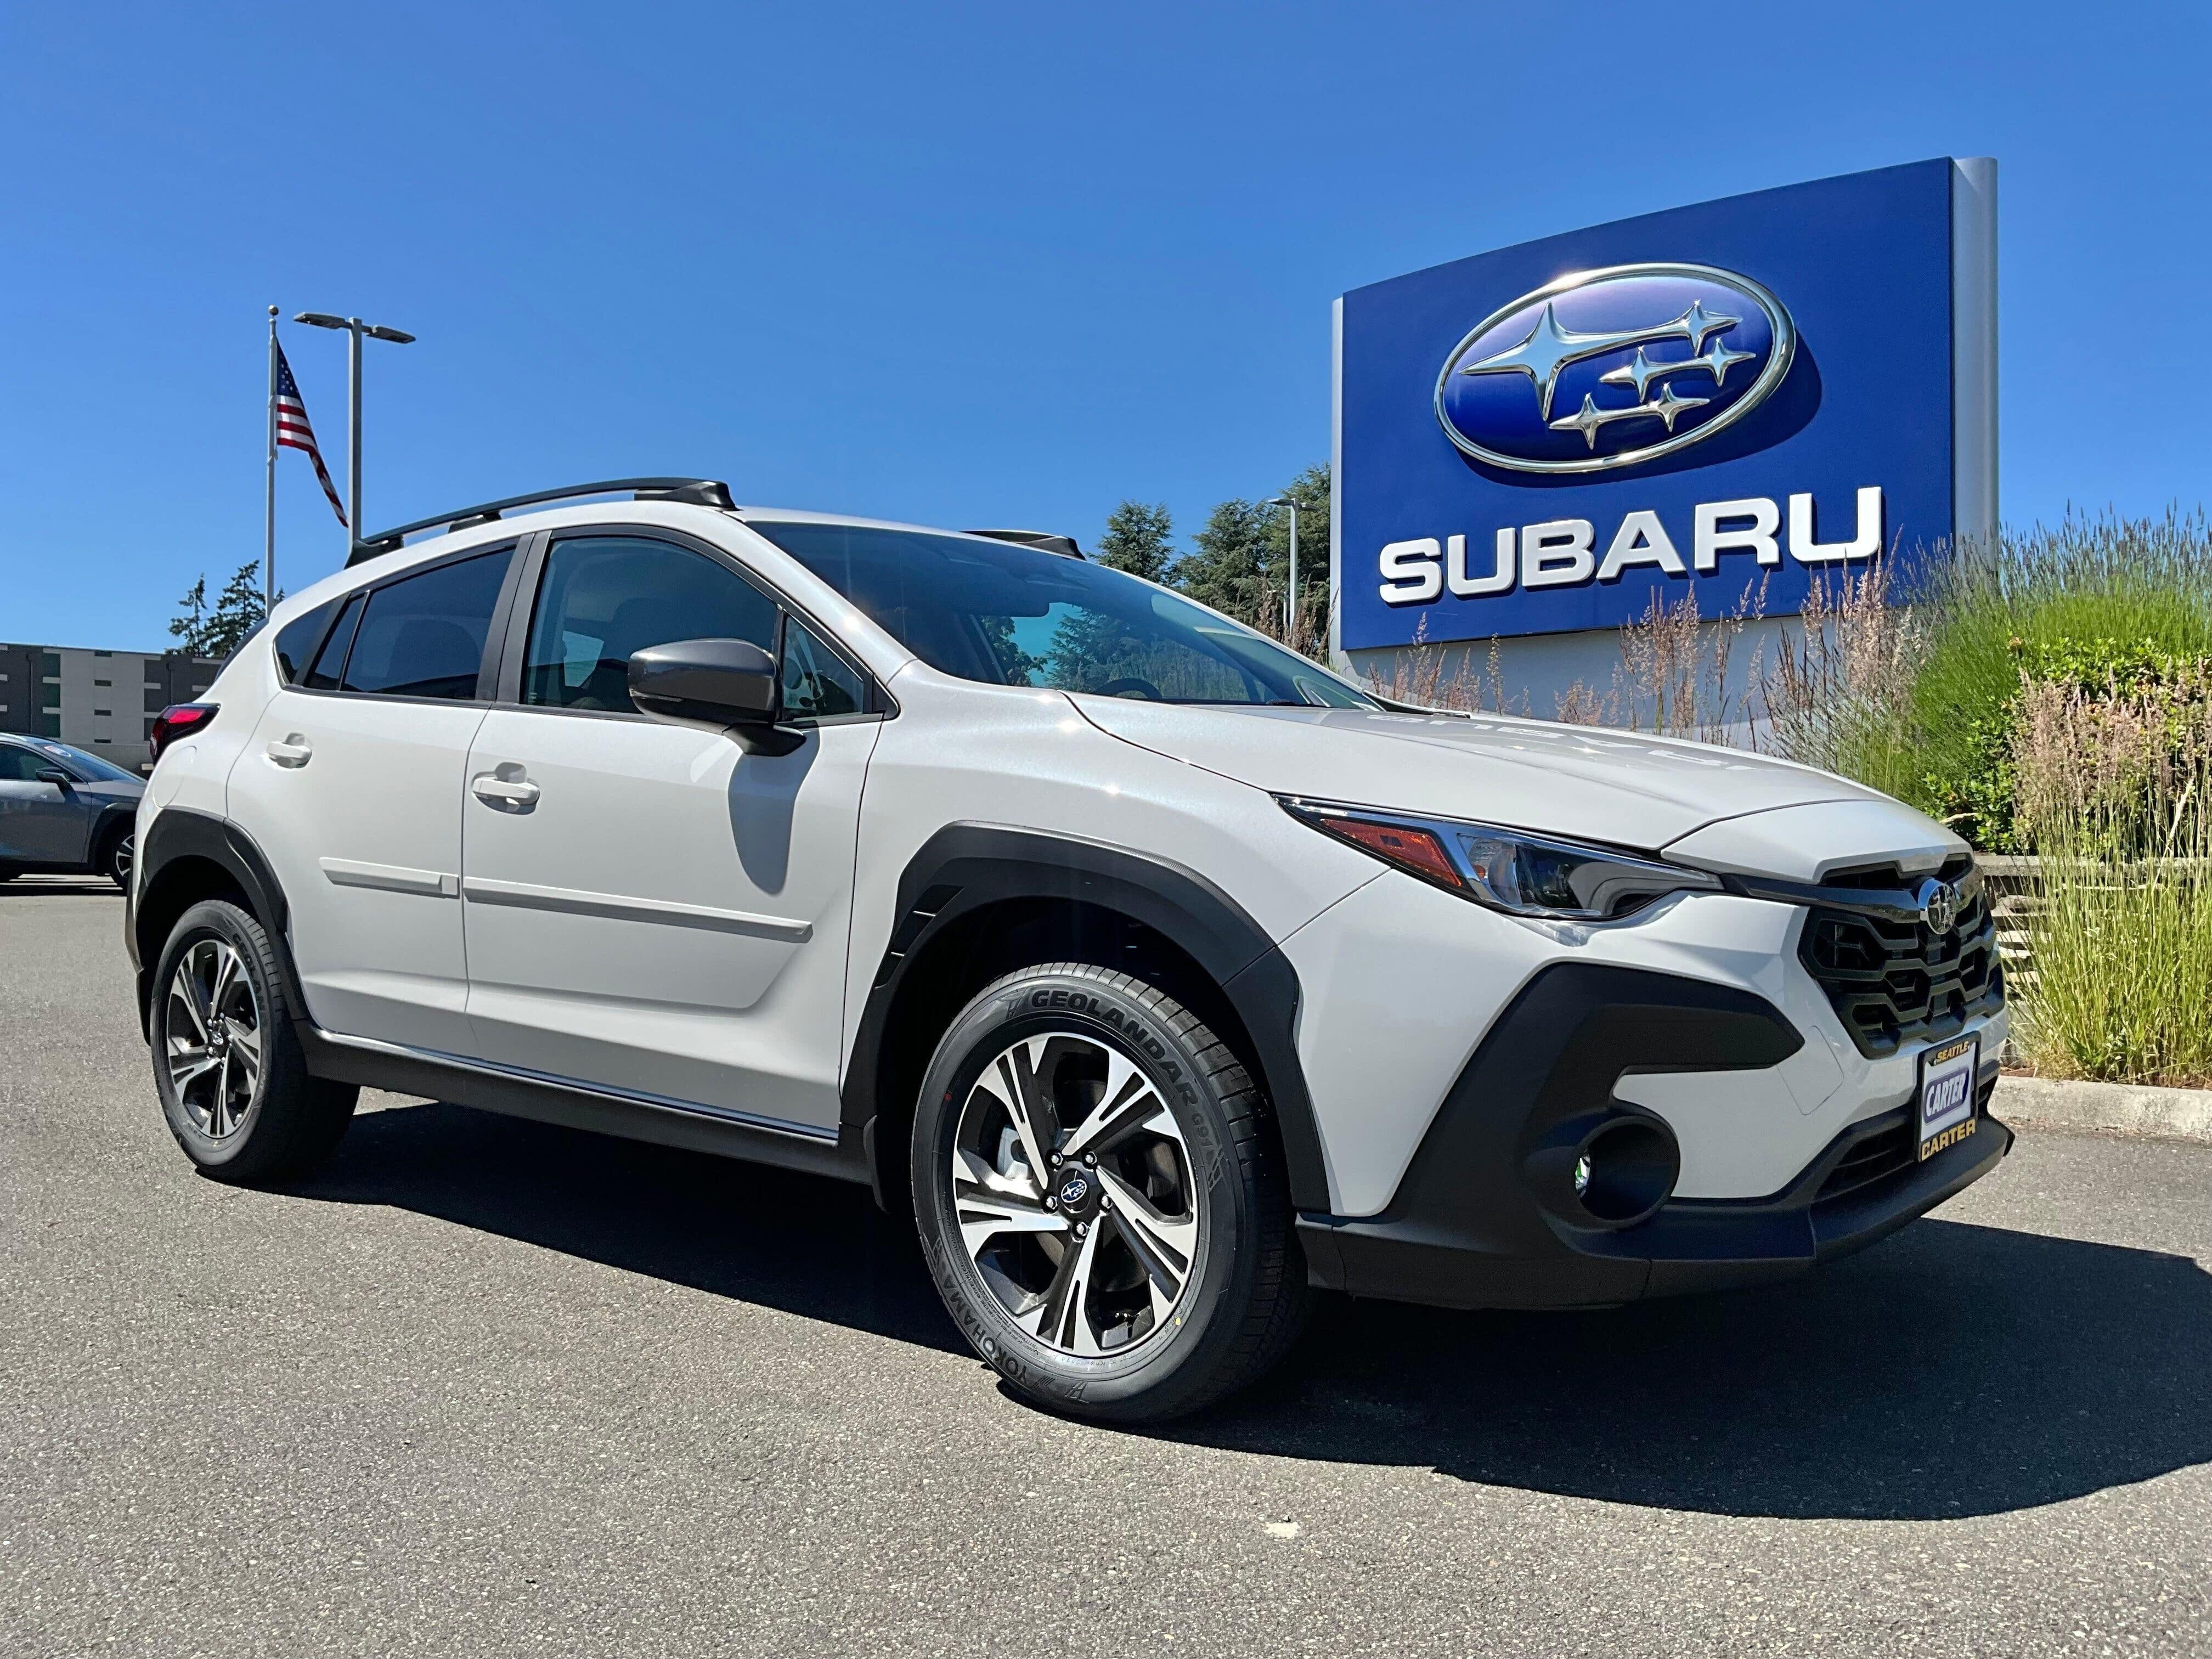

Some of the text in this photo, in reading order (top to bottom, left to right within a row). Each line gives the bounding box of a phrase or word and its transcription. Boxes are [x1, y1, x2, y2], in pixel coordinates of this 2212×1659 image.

[1379, 486, 1882, 603] SUBARU
[1031, 990, 1199, 1107] GEOLANDAR
[1936, 1041, 1970, 1062] SEATTLE
[1926, 1073, 1966, 1117] CARTER
[1921, 1118, 1976, 1161] CARTER
[943, 1271, 1028, 1385] YOKOHAMA
